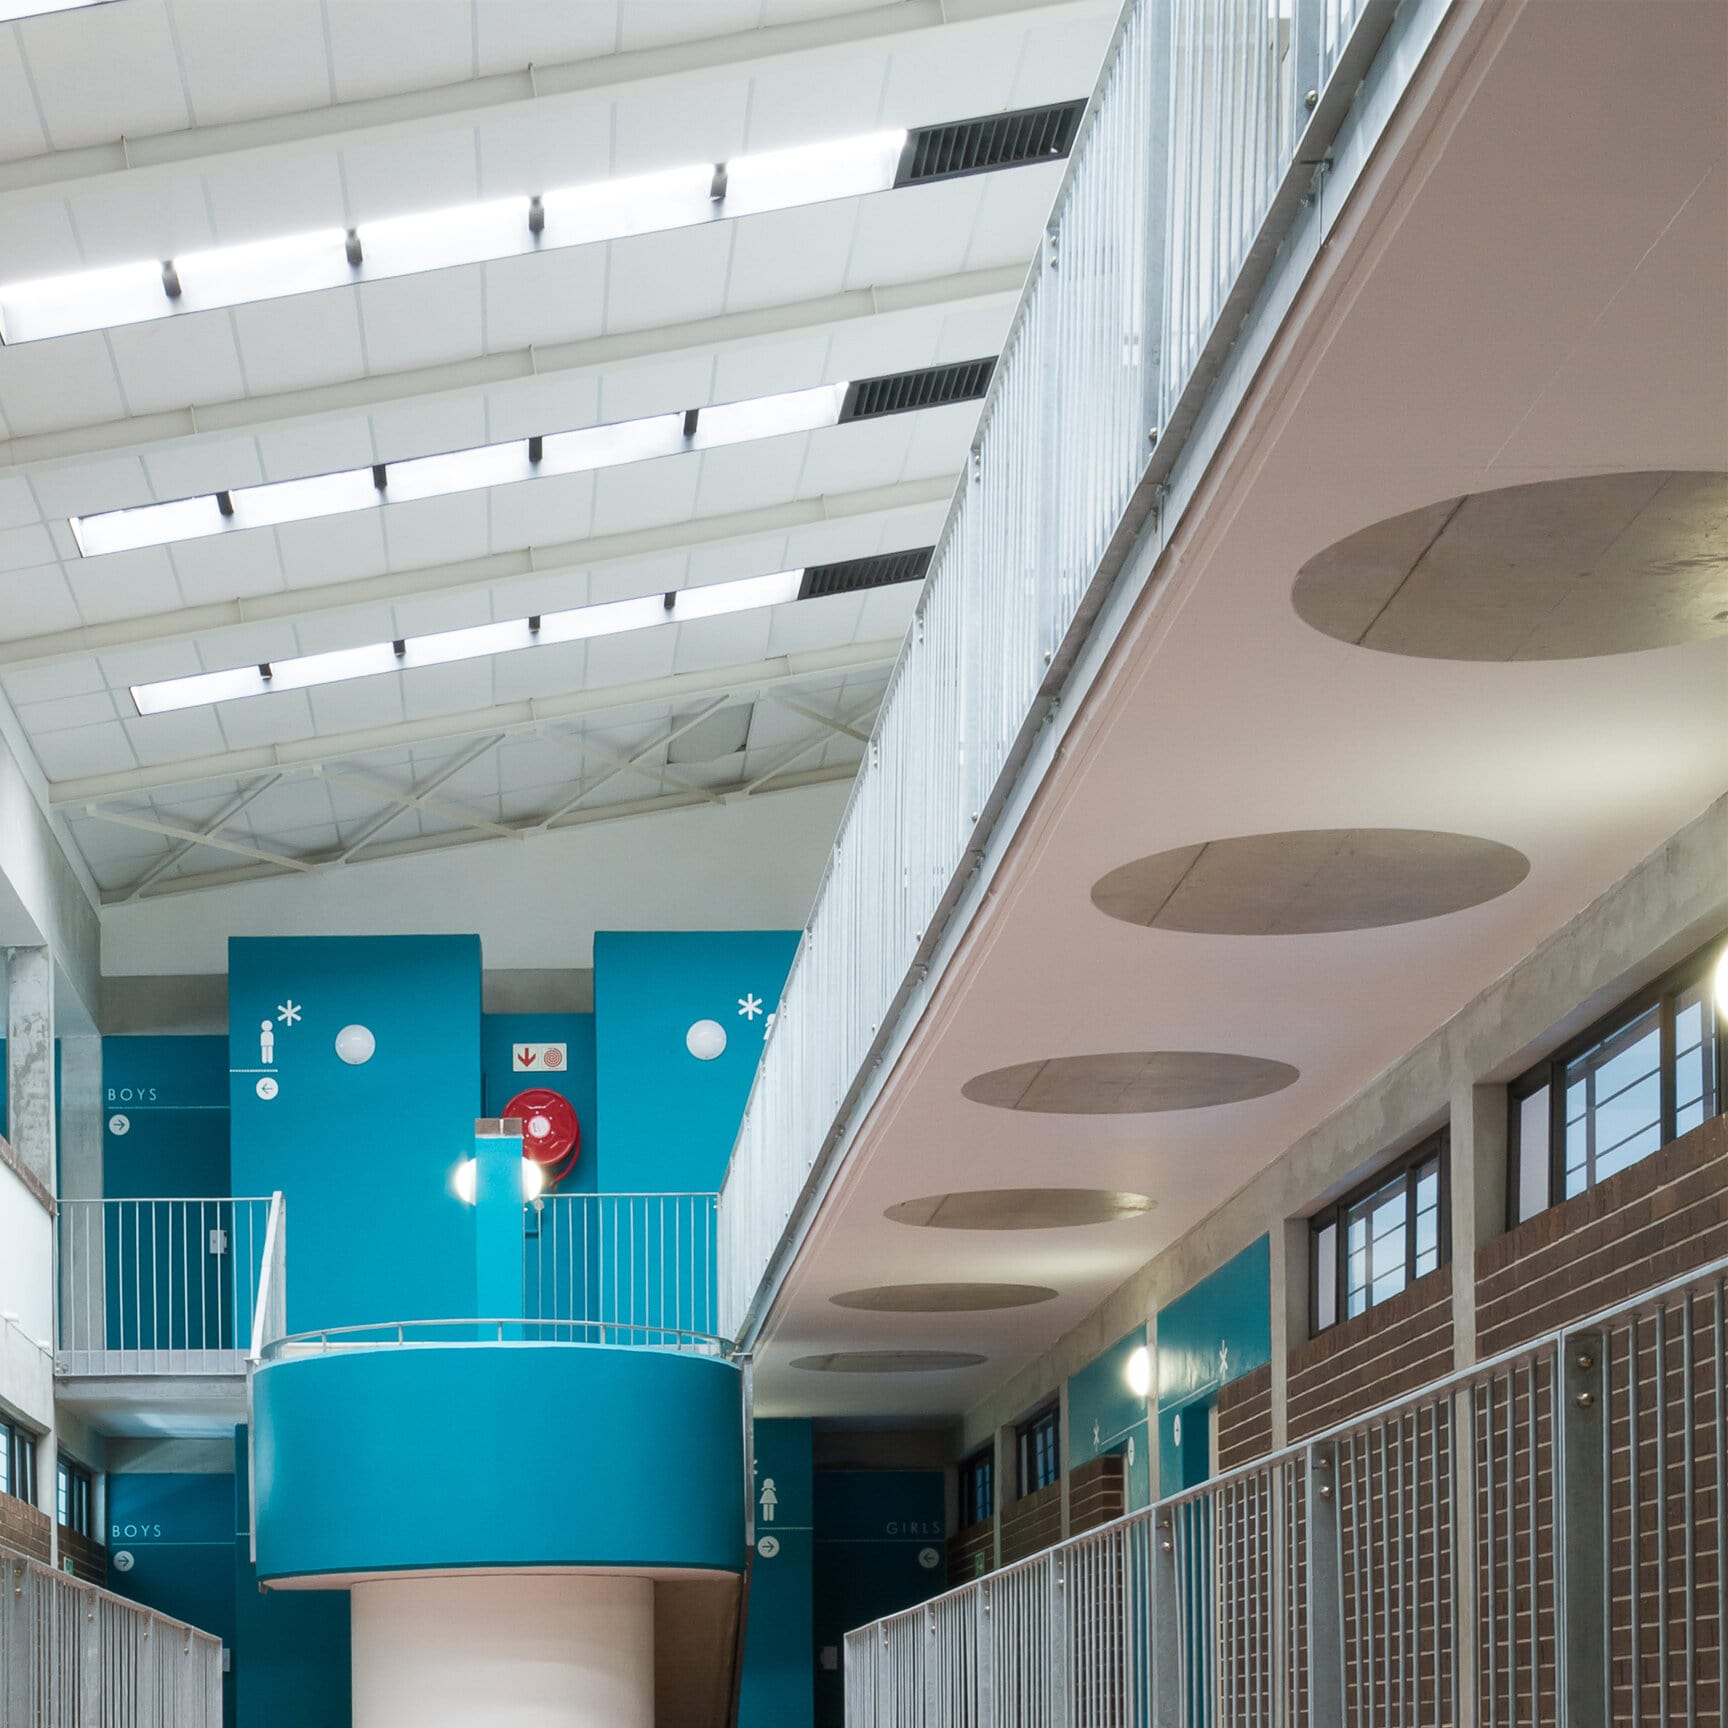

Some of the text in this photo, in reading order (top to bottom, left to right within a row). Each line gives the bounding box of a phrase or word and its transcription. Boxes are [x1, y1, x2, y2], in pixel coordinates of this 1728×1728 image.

[108, 1088, 157, 1101] BOYS
[112, 1524, 161, 1538] BOYS
[886, 1521, 940, 1535] GIRLS
